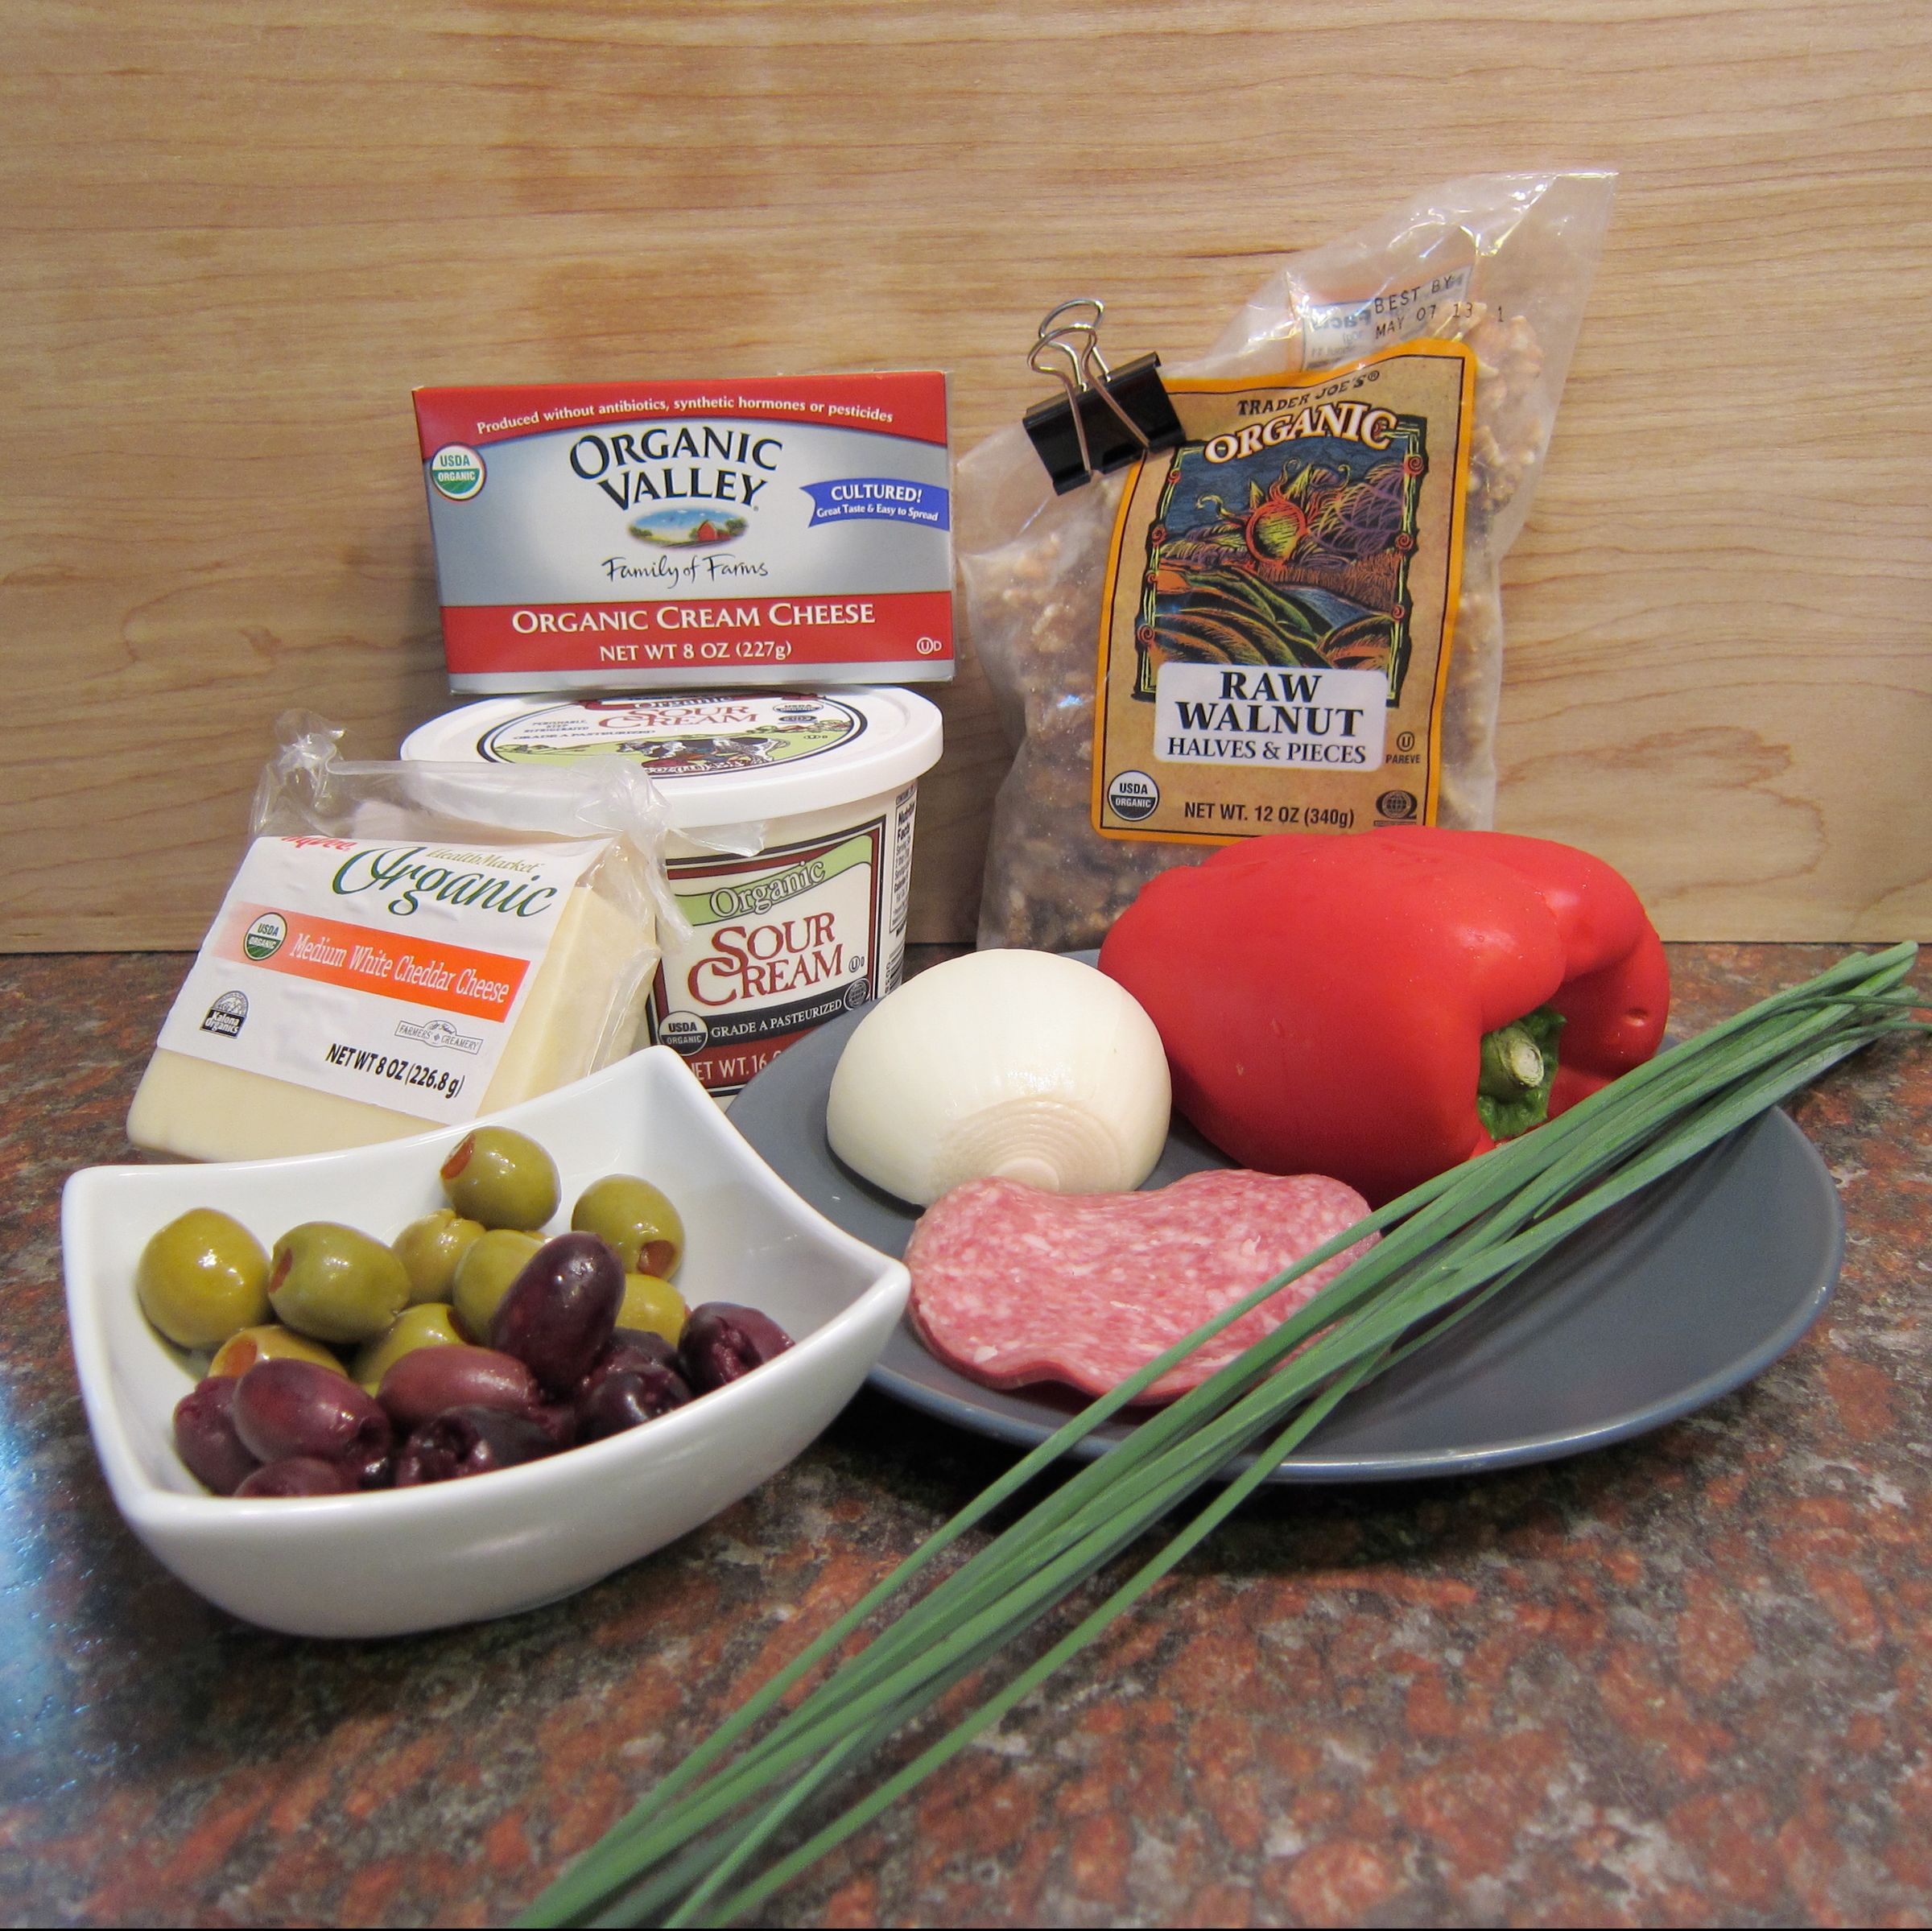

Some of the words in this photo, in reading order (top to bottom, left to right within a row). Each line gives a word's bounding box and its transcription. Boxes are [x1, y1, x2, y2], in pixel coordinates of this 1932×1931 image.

[1374, 286, 1420, 314] BEST
[1431, 274, 1452, 294] BY
[1375, 316, 1404, 340] MAY
[1416, 304, 1436, 320] 07
[1451, 303, 1473, 319] 13
[477, 411, 539, 434] Produced
[543, 406, 595, 423] without
[599, 399, 670, 415] antibiotics,
[674, 396, 734, 411] synthetic
[738, 396, 806, 411] hormones
[810, 402, 824, 412] or
[828, 404, 894, 423] pesticides
[1238, 394, 1308, 417] TRADER
[1203, 401, 1397, 464] ORGANIC
[440, 455, 471, 467] USDA
[570, 426, 783, 480] ORGANIC
[438, 471, 476, 481] ORGANIC
[597, 466, 768, 510] VALLEY
[831, 484, 923, 502] CULTURED!
[817, 505, 840, 518] Great
[842, 503, 865, 514] Taste
[867, 504, 874, 514] &
[877, 504, 896, 518] Easy
[898, 506, 906, 516] to
[908, 508, 938, 522] Spread
[601, 555, 681, 588] Family
[683, 556, 700, 584] of
[703, 553, 769, 580] Farms
[512, 609, 649, 634] ORGANIC
[656, 606, 762, 630] CREAM
[768, 603, 876, 626] CHEESE
[600, 645, 638, 662] NET
[645, 644, 677, 660] WT
[683, 643, 695, 659] 8
[700, 642, 730, 658] OZ
[736, 640, 792, 661] (227g)
[1219, 670, 1322, 703] RAW
[629, 706, 749, 721] SOUR
[634, 696, 733, 709] Organic
[599, 713, 758, 728] CREAM
[1174, 701, 1364, 737] WALNUT
[1167, 737, 1256, 760] HALVES
[1263, 741, 1280, 759] &
[1287, 742, 1366, 764] PIECES
[1385, 753, 1421, 764] PAREVE
[1119, 782, 1148, 795] USDA
[1115, 797, 1151, 808] ORGANIC
[1184, 802, 1216, 819] NET
[1220, 803, 1248, 821] WT.
[1255, 806, 1274, 821] 12
[1278, 806, 1299, 823] OZ
[1303, 807, 1354, 827] (340g)
[427, 848, 541, 873] HealthMarket
[332, 846, 558, 917] Organic
[710, 860, 827, 918] Organic
[258, 923, 279, 937] USDA
[248, 936, 277, 950] ORGANIC
[712, 911, 836, 976] SOUR
[289, 933, 347, 968] Medium
[349, 945, 393, 978] White
[394, 955, 456, 992] Cheddar
[456, 968, 510, 1003] Cheese
[687, 943, 844, 1006] CREAM
[204, 1017, 239, 1034] Organics
[213, 1011, 239, 1026] Kalona
[668, 1022, 697, 1033] USDA
[712, 1022, 756, 1038] GRADE
[760, 1020, 768, 1031] A
[770, 1000, 842, 1029] PASTEURIZED
[441, 1036, 480, 1050] CREAMERY
[667, 1034, 703, 1046] ORGANIC
[325, 1043, 357, 1067] NET
[353, 1050, 378, 1072] WT
[376, 1056, 387, 1075] 8
[386, 1058, 409, 1080] OZ
[405, 1062, 450, 1091] (226.8
[719, 1057, 749, 1078] WT.
[752, 1053, 766, 1073] 16
